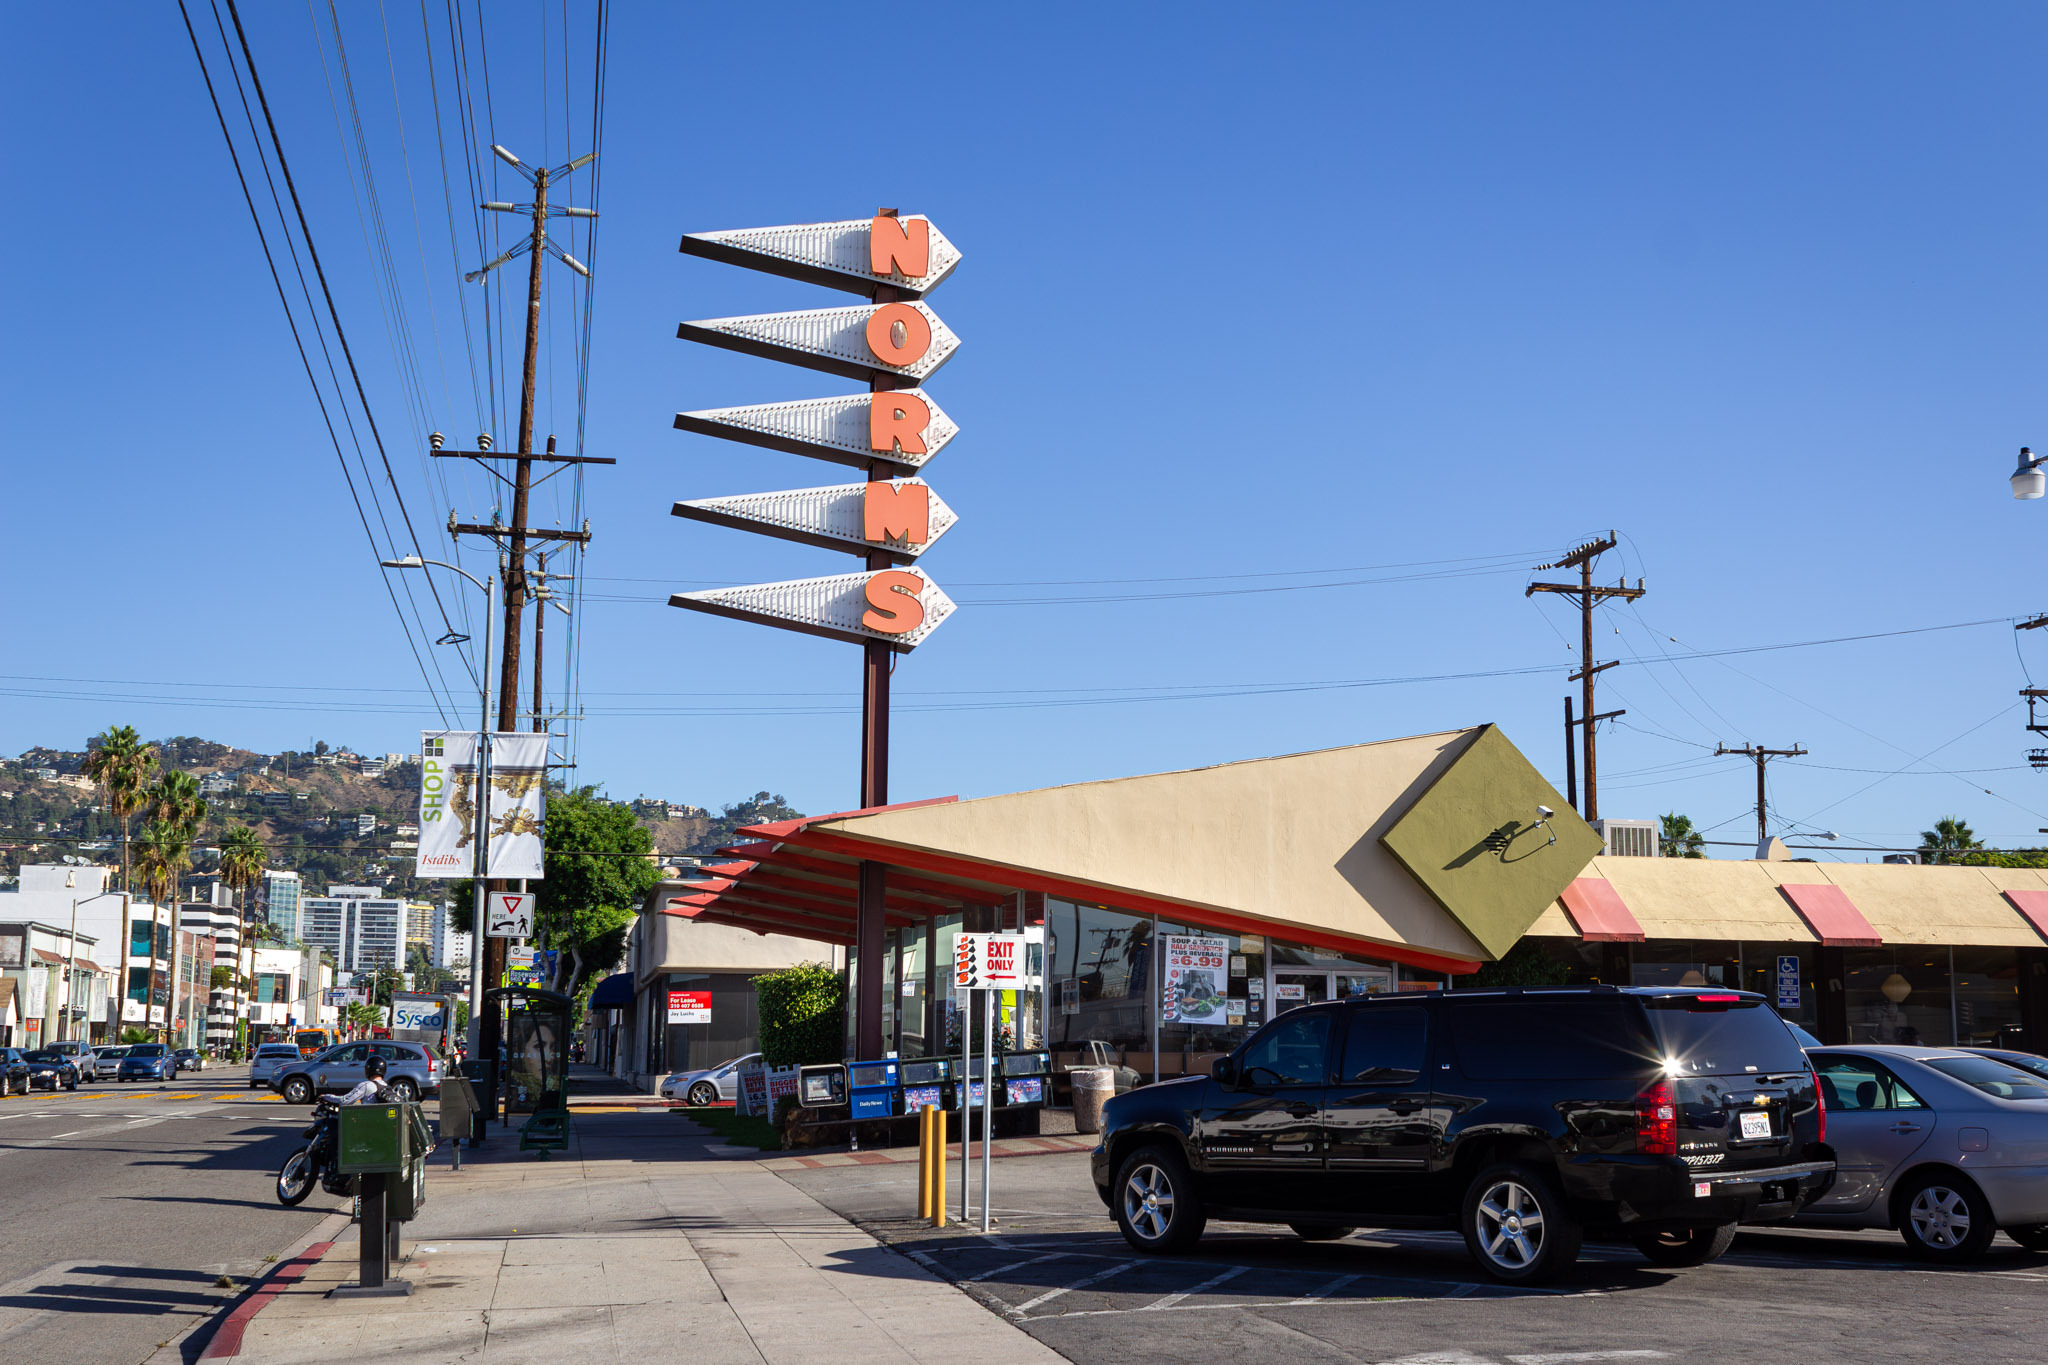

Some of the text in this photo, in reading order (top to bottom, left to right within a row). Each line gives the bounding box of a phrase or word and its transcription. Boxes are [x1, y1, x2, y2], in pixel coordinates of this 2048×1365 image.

[862, 216, 932, 634] NORMS
[423, 760, 444, 822] SHOP
[1171, 937, 1192, 945] SOUP
[987, 942, 1014, 958] EXIT
[1189, 950, 1223, 958] BEVERAGE
[958, 935, 969, 984] NORMS
[987, 959, 1014, 971] ONLY
[1170, 955, 1223, 968] $6.99
[510, 970, 539, 978] Rosewood
[396, 1009, 442, 1029] Sysco
[769, 1078, 798, 1087] BIGGER
[770, 1085, 798, 1093] BETTER
[749, 1092, 767, 1100] $6.5
